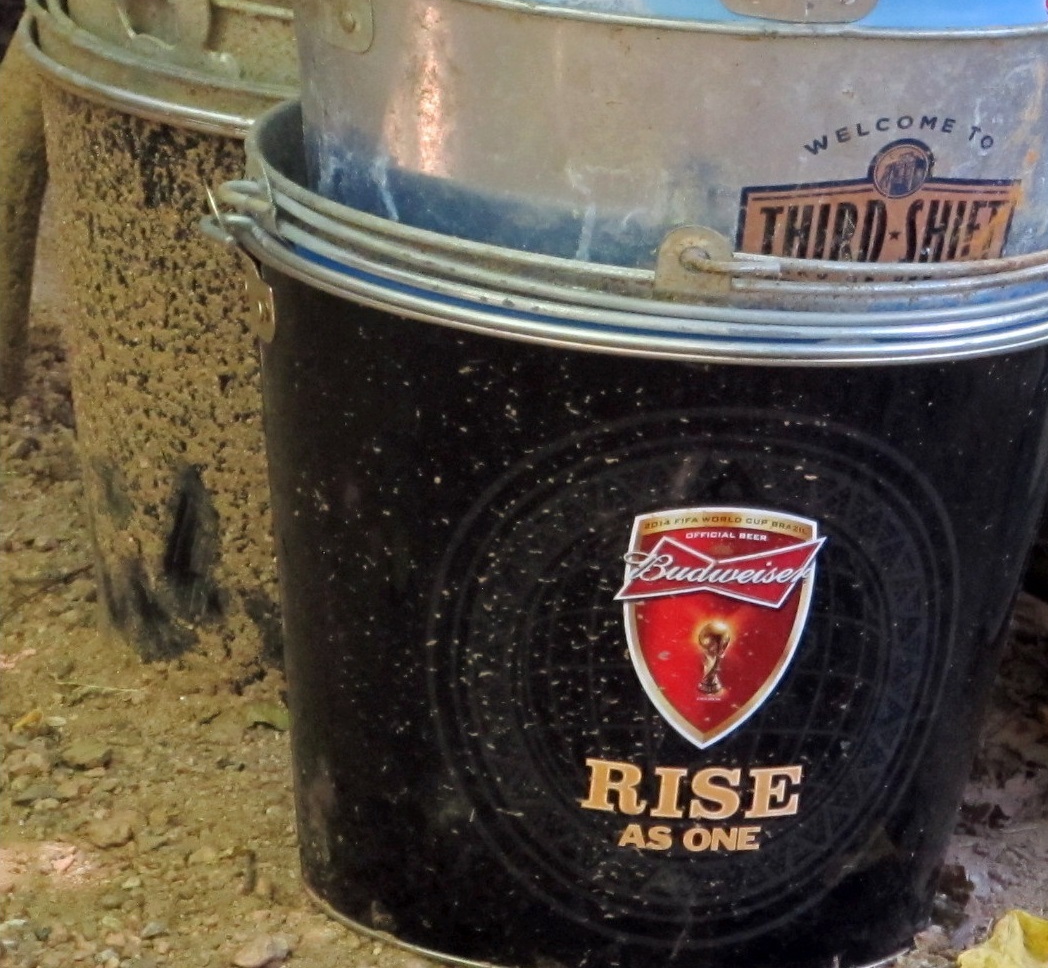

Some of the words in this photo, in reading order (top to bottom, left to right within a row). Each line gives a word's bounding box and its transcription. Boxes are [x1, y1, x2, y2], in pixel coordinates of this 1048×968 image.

[803, 115, 957, 156] WELCOME
[968, 125, 995, 150] TO
[760, 199, 888, 263] THIRD
[643, 520, 671, 530] 2014
[674, 517, 699, 525] FIFA
[702, 516, 742, 524] WORLD
[745, 517, 769, 525] CUP
[771, 521, 807, 533] BRAZIL
[685, 531, 736, 540] OFFICIAL
[738, 532, 768, 542] BEER
[623, 551, 815, 584] Budweiser
[579, 758, 803, 819] RISE
[617, 823, 674, 850] AS
[682, 825, 762, 852] ONE
